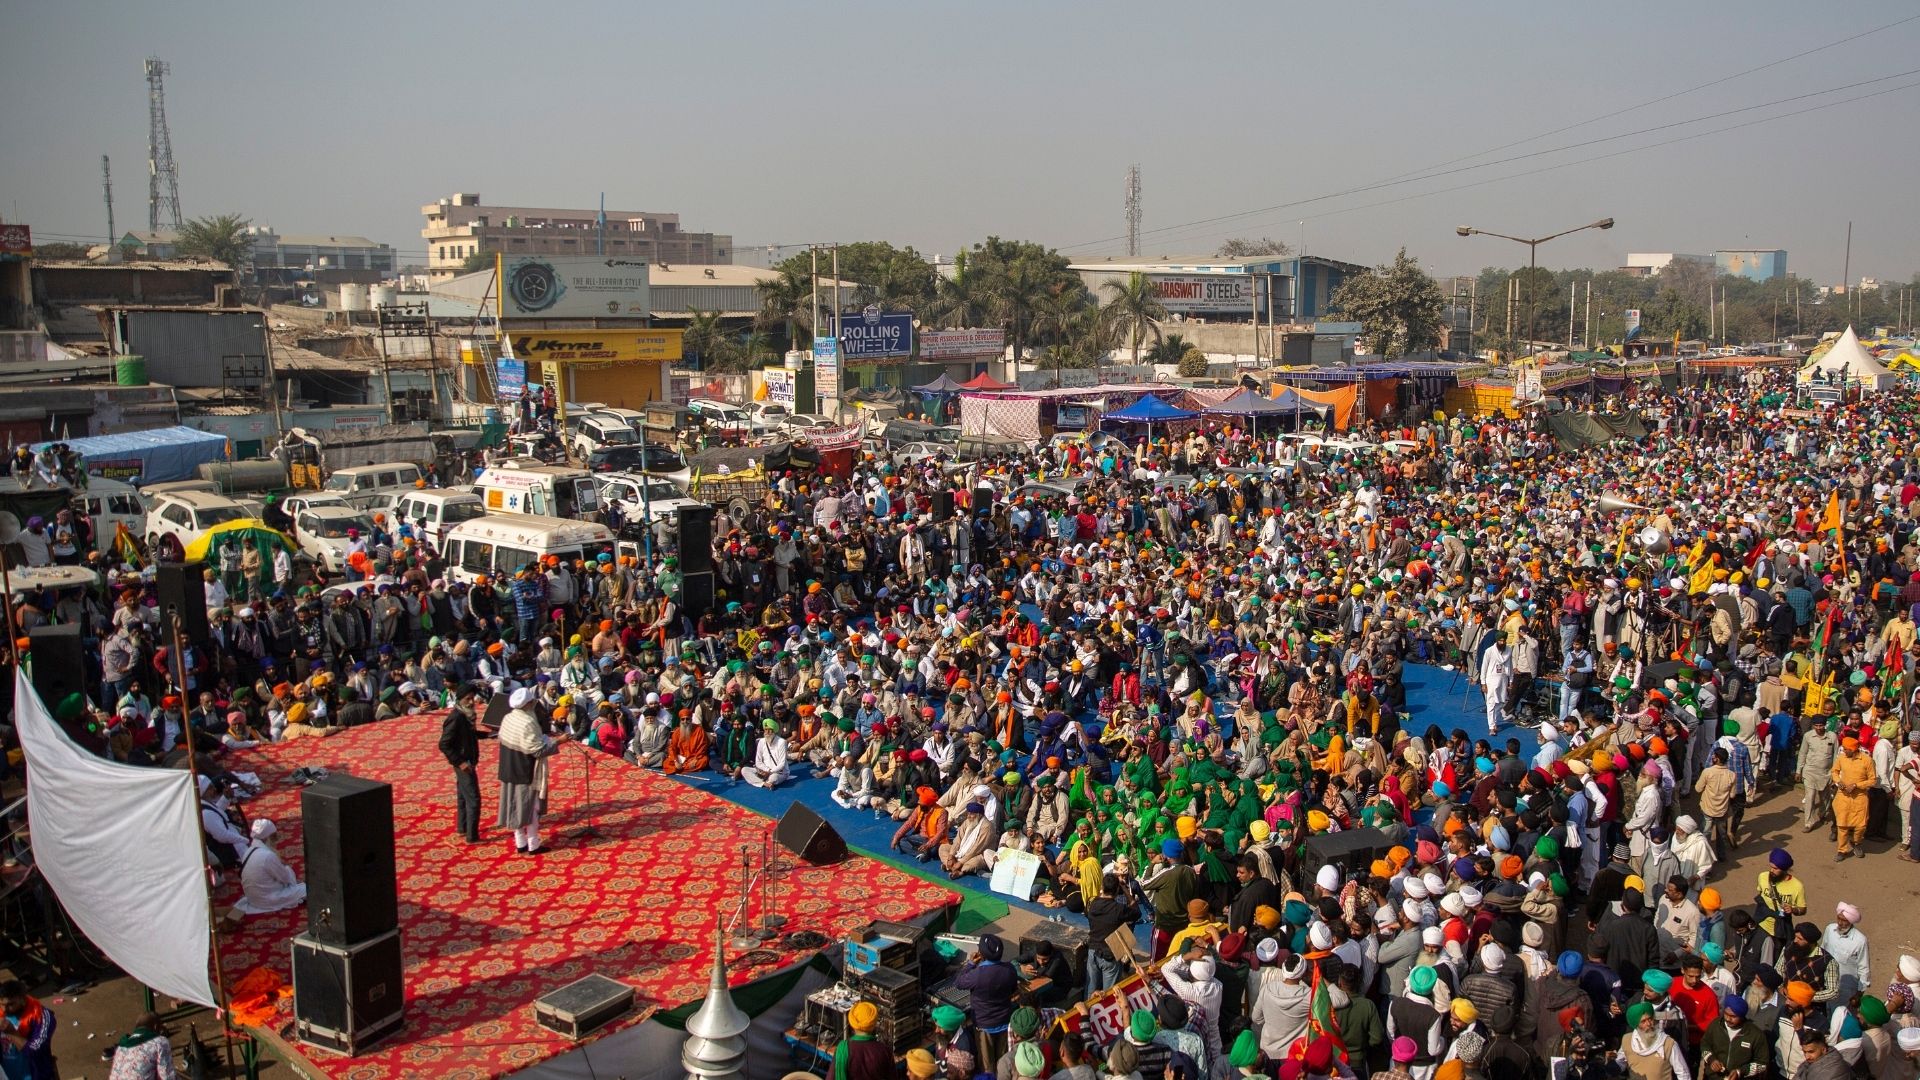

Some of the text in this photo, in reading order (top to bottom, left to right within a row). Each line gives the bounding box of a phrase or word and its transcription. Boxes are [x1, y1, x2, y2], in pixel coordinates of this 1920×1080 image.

[625, 278, 642, 287] STYLE
[1153, 281, 1240, 299] SARASWATI STEELS
[843, 326, 900, 339] ROLLING
[844, 338, 899, 353] WHEELZ
[549, 351, 577, 359] STEEL
